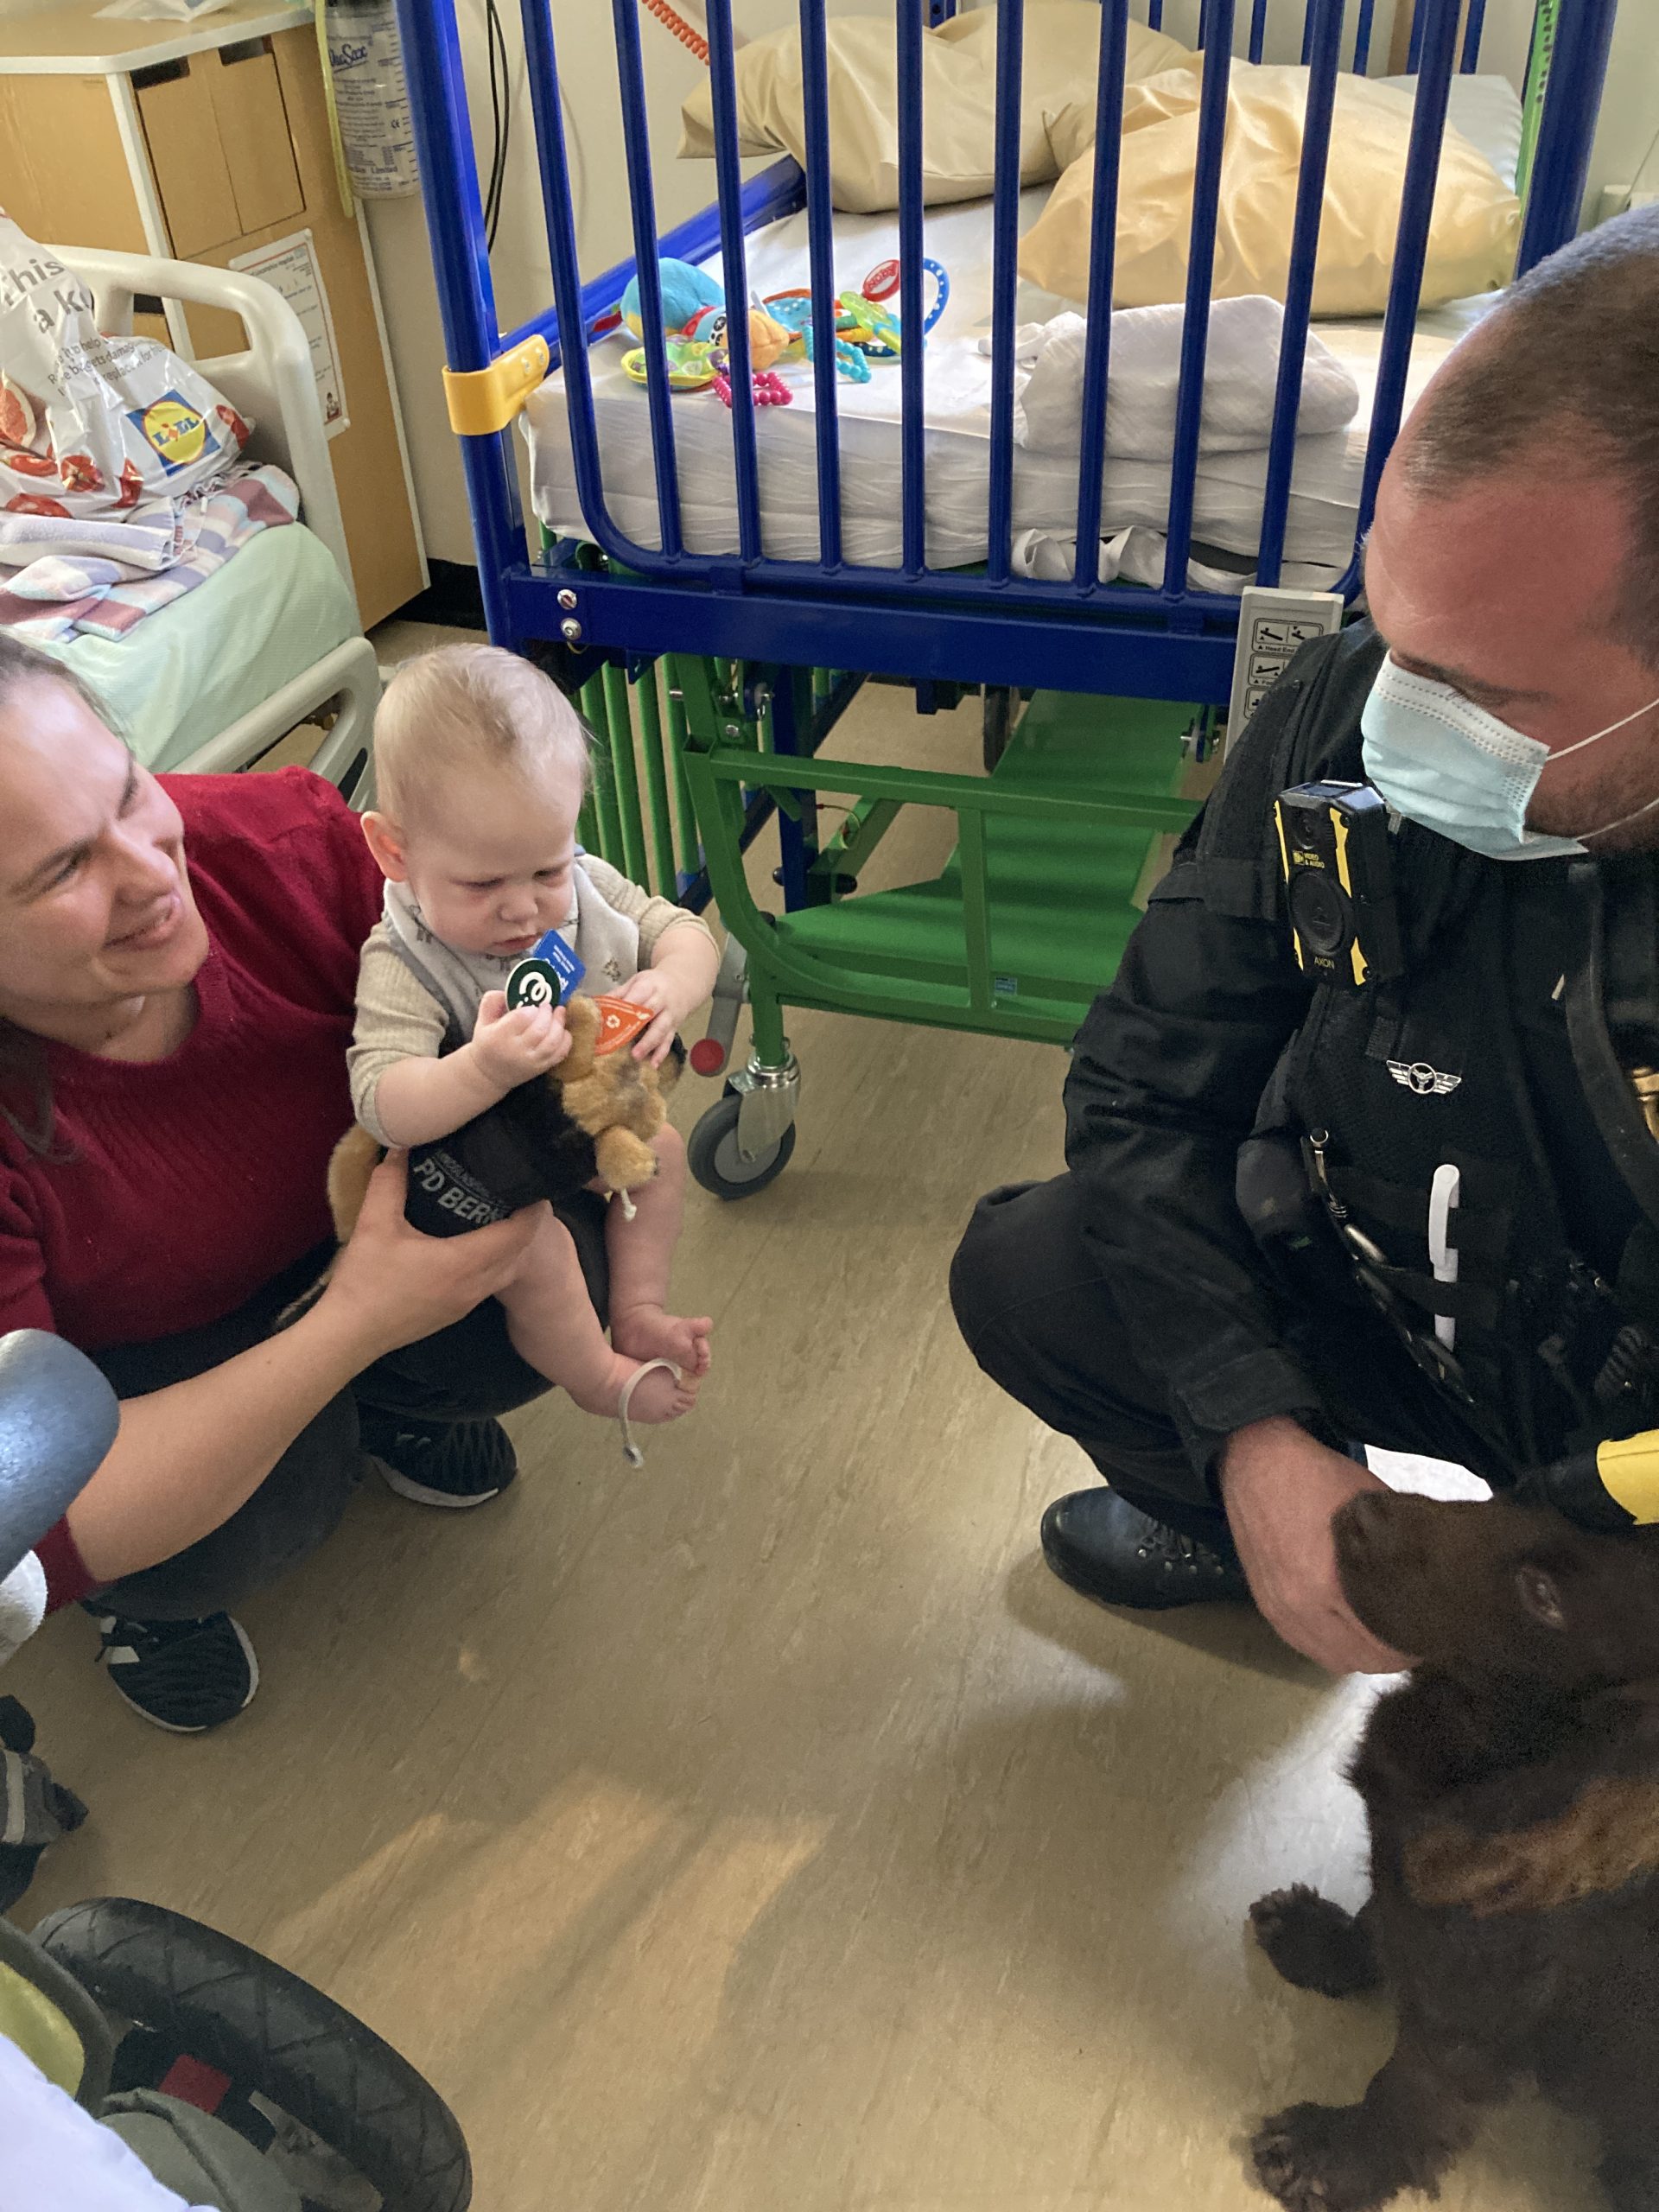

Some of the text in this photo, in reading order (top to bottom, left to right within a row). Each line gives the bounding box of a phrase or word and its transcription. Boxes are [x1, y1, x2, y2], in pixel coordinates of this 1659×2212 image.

[79, 337, 101, 352] help
[1304, 853, 1319, 861] VIDEO
[1313, 957, 1335, 969] AXON
[413, 1159, 445, 1192] PD
